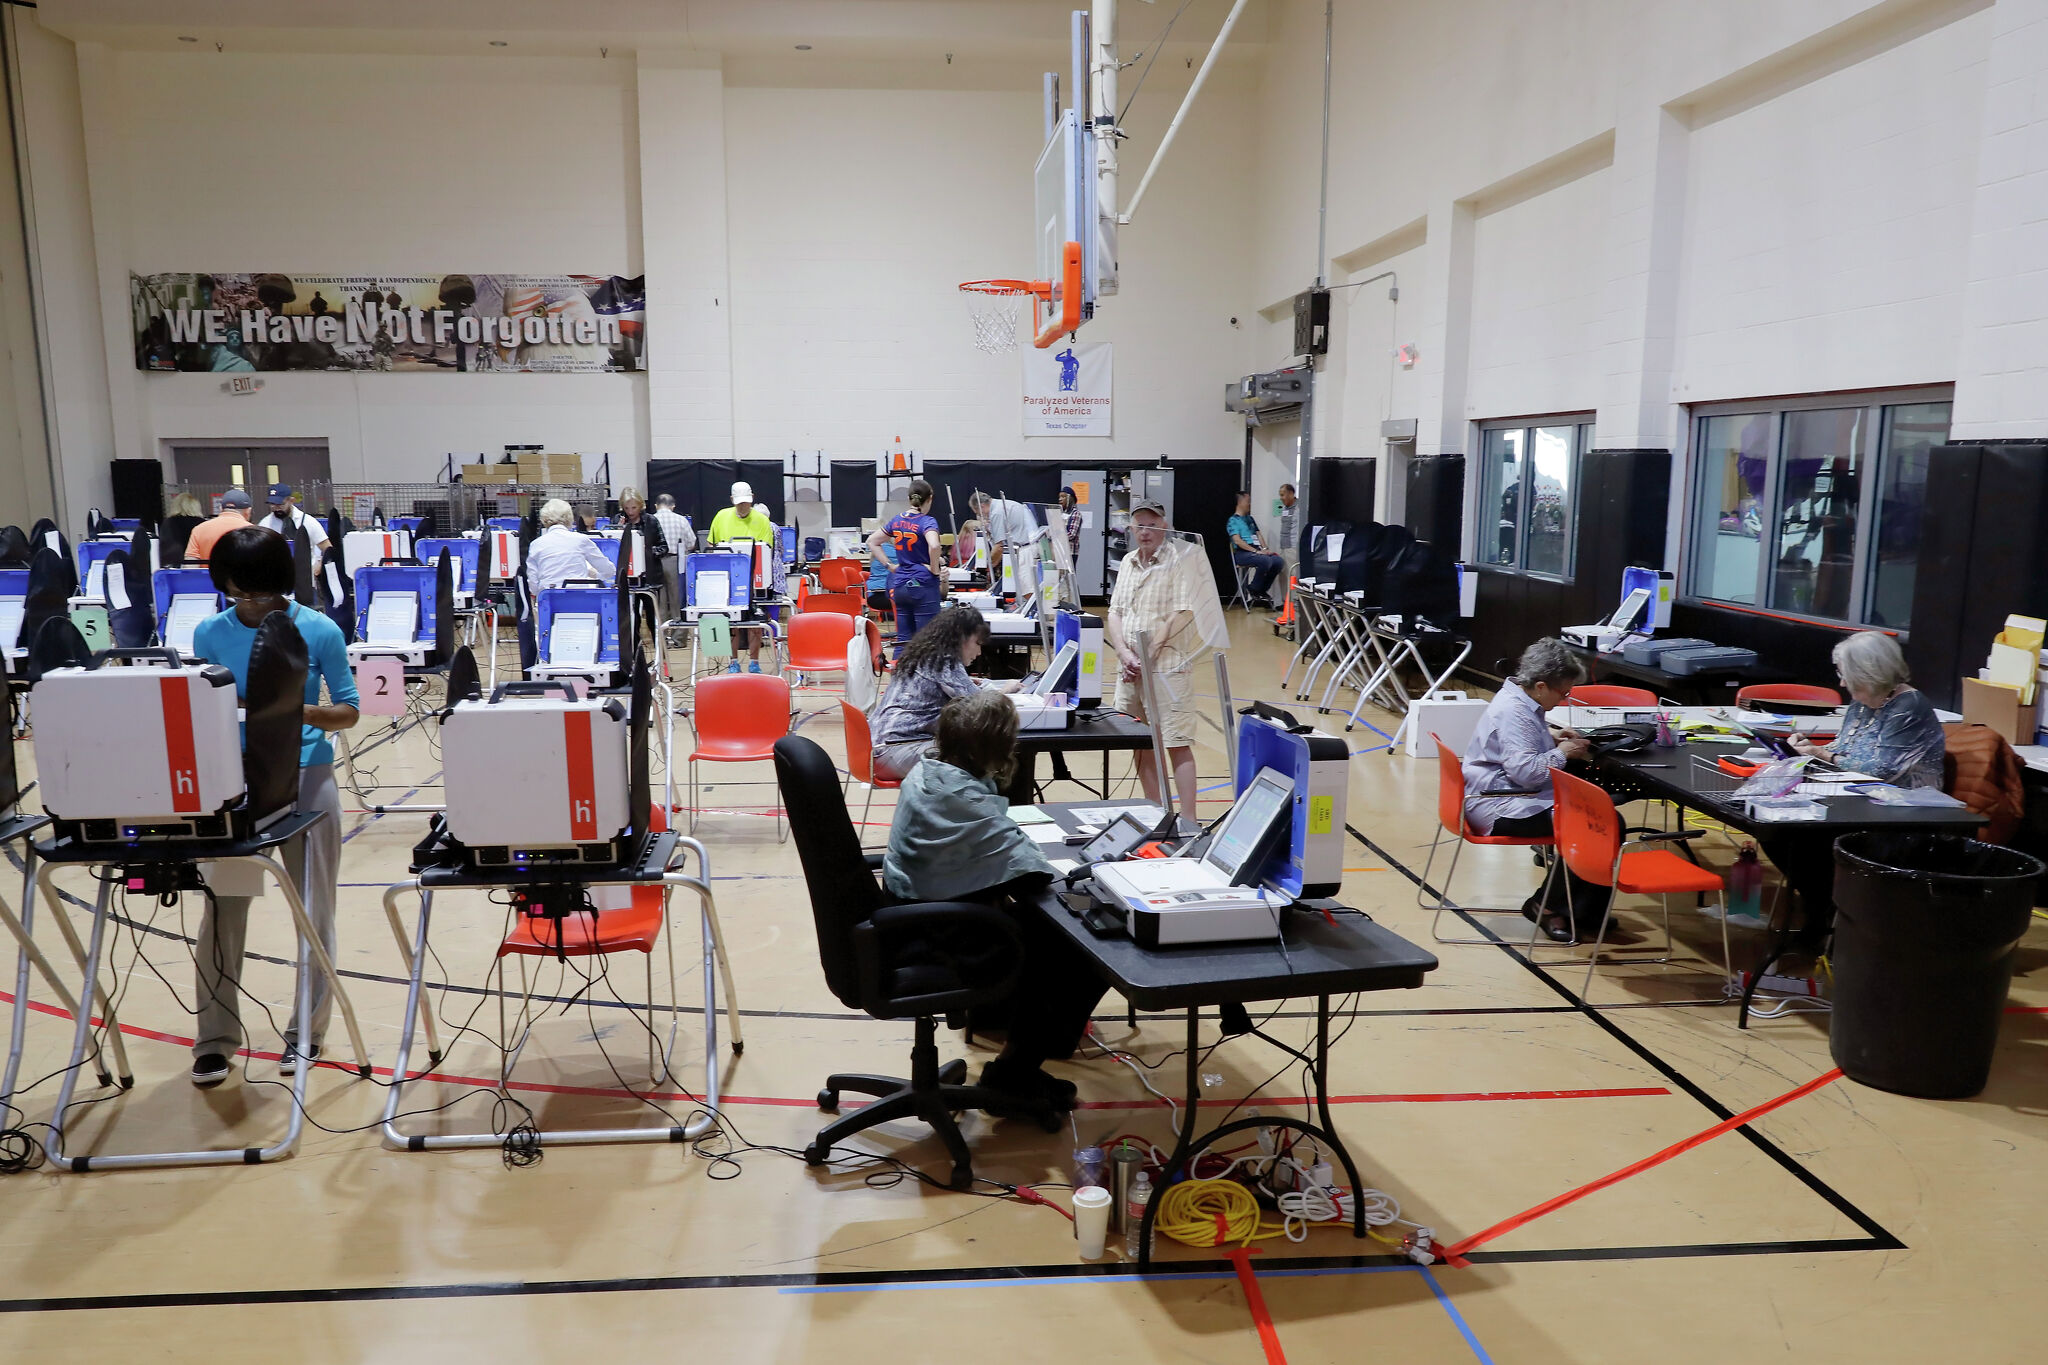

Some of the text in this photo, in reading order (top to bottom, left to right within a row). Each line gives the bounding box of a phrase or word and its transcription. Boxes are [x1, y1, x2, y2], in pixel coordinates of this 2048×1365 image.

[163, 301, 622, 348] WE Have Not Forgotten
[233, 377, 251, 392] EXIT
[1023, 396, 1110, 406] Paralyzed Veterans
[1042, 407, 1091, 415] of America
[893, 530, 918, 552] 27
[85, 619, 97, 636] 5
[710, 627, 720, 643] 1
[375, 675, 389, 696] 2
